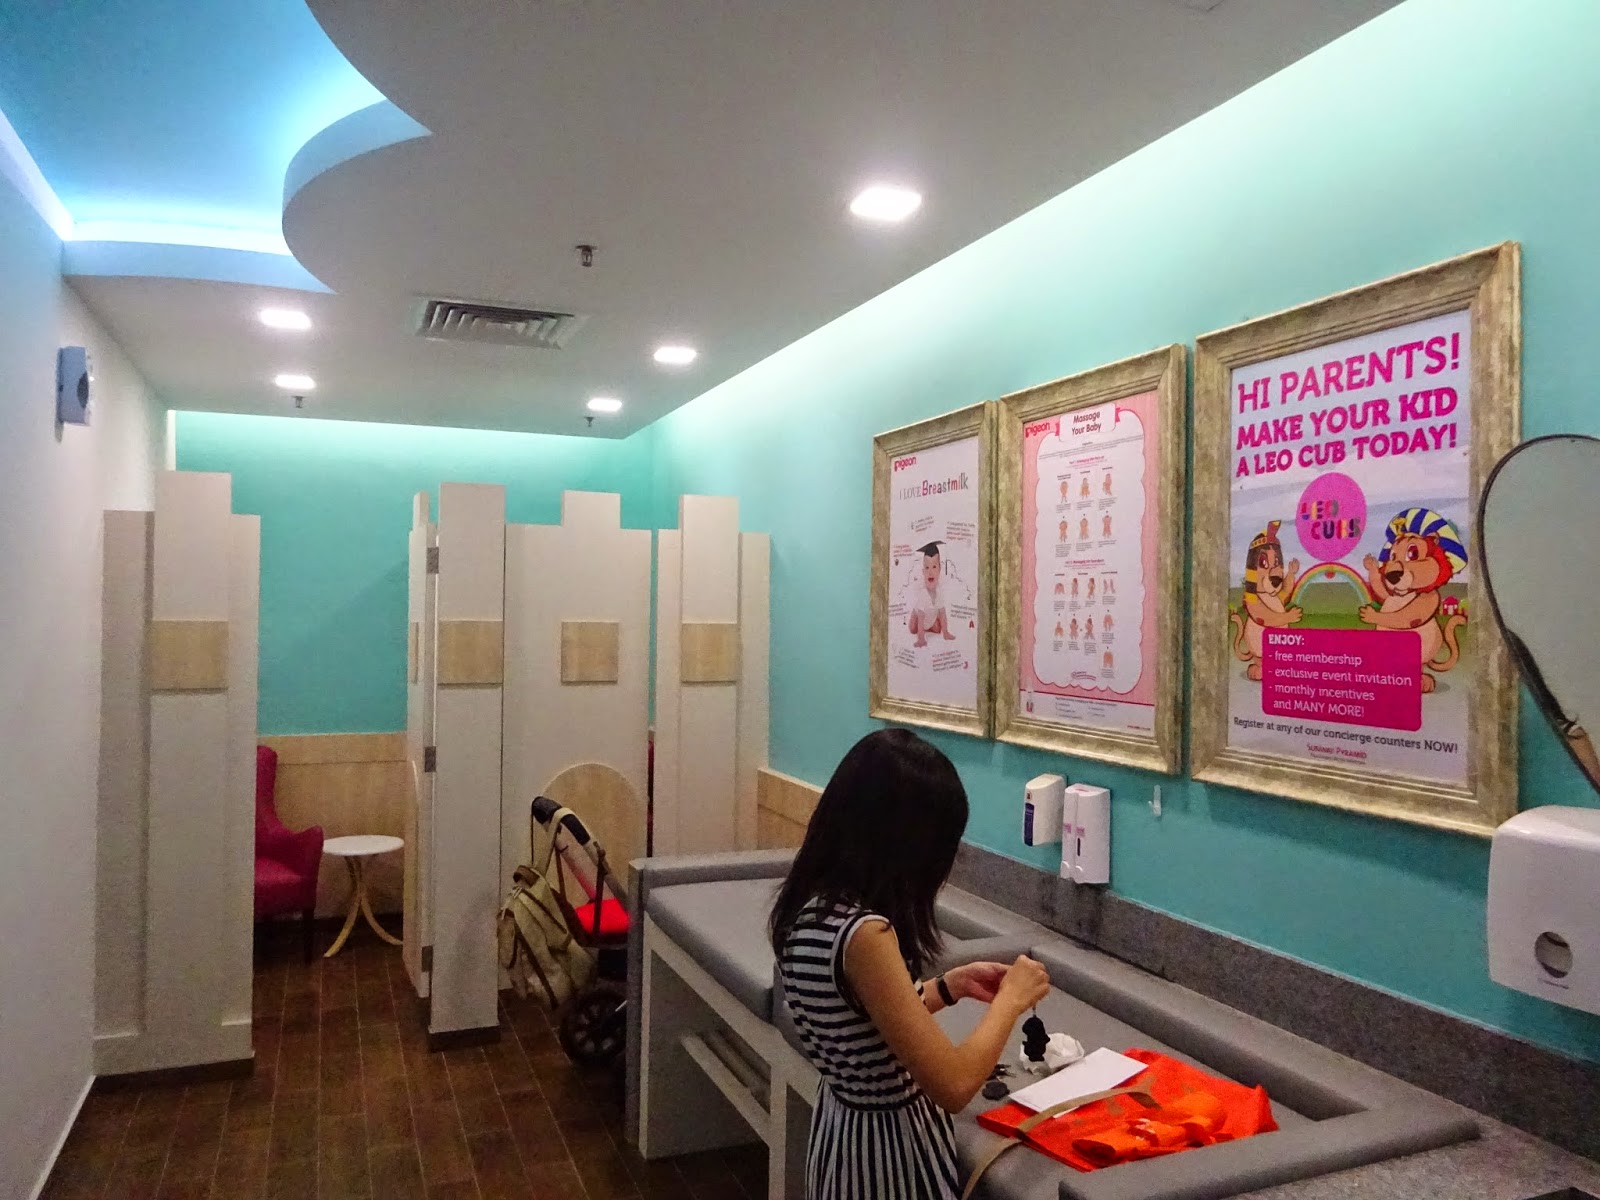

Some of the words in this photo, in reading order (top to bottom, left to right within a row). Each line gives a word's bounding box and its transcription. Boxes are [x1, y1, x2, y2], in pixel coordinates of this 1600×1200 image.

[1238, 377, 1271, 414] HI
[1280, 332, 1460, 405] PARENTS!
[1073, 410, 1101, 424] Massage
[1236, 414, 1304, 451] MAKE
[1310, 398, 1391, 437] YOUR
[1398, 386, 1458, 423] KID
[1025, 422, 1051, 438] pigeon
[1071, 426, 1085, 436] Your
[1086, 422, 1102, 434] Baby
[1236, 456, 1250, 477] A
[1254, 449, 1293, 475] LEO
[1298, 440, 1346, 468] CUB
[1353, 422, 1458, 460] TODAY!
[894, 456, 917, 472] pigeon
[922, 472, 969, 497] Breastmilk
[1268, 634, 1305, 647] ENJOY:
[1274, 651, 1293, 662] free
[1295, 652, 1363, 668] membership
[1275, 668, 1319, 681] exclusive
[1321, 671, 1352, 682] event
[1355, 673, 1412, 687] invitation
[1275, 684, 1316, 698] monthly
[1319, 687, 1375, 702] incentives
[1273, 699, 1292, 710] and
[1293, 701, 1326, 714] MANY
[1328, 705, 1365, 718] MORE!
[1233, 716, 1265, 730] Register
[1266, 722, 1275, 731] at
[1276, 724, 1292, 735] any
[1293, 725, 1303, 734] of
[1304, 728, 1321, 737] our
[1324, 729, 1372, 745] concierge
[1374, 735, 1421, 750] counters
[1424, 739, 1458, 755] NOW!
